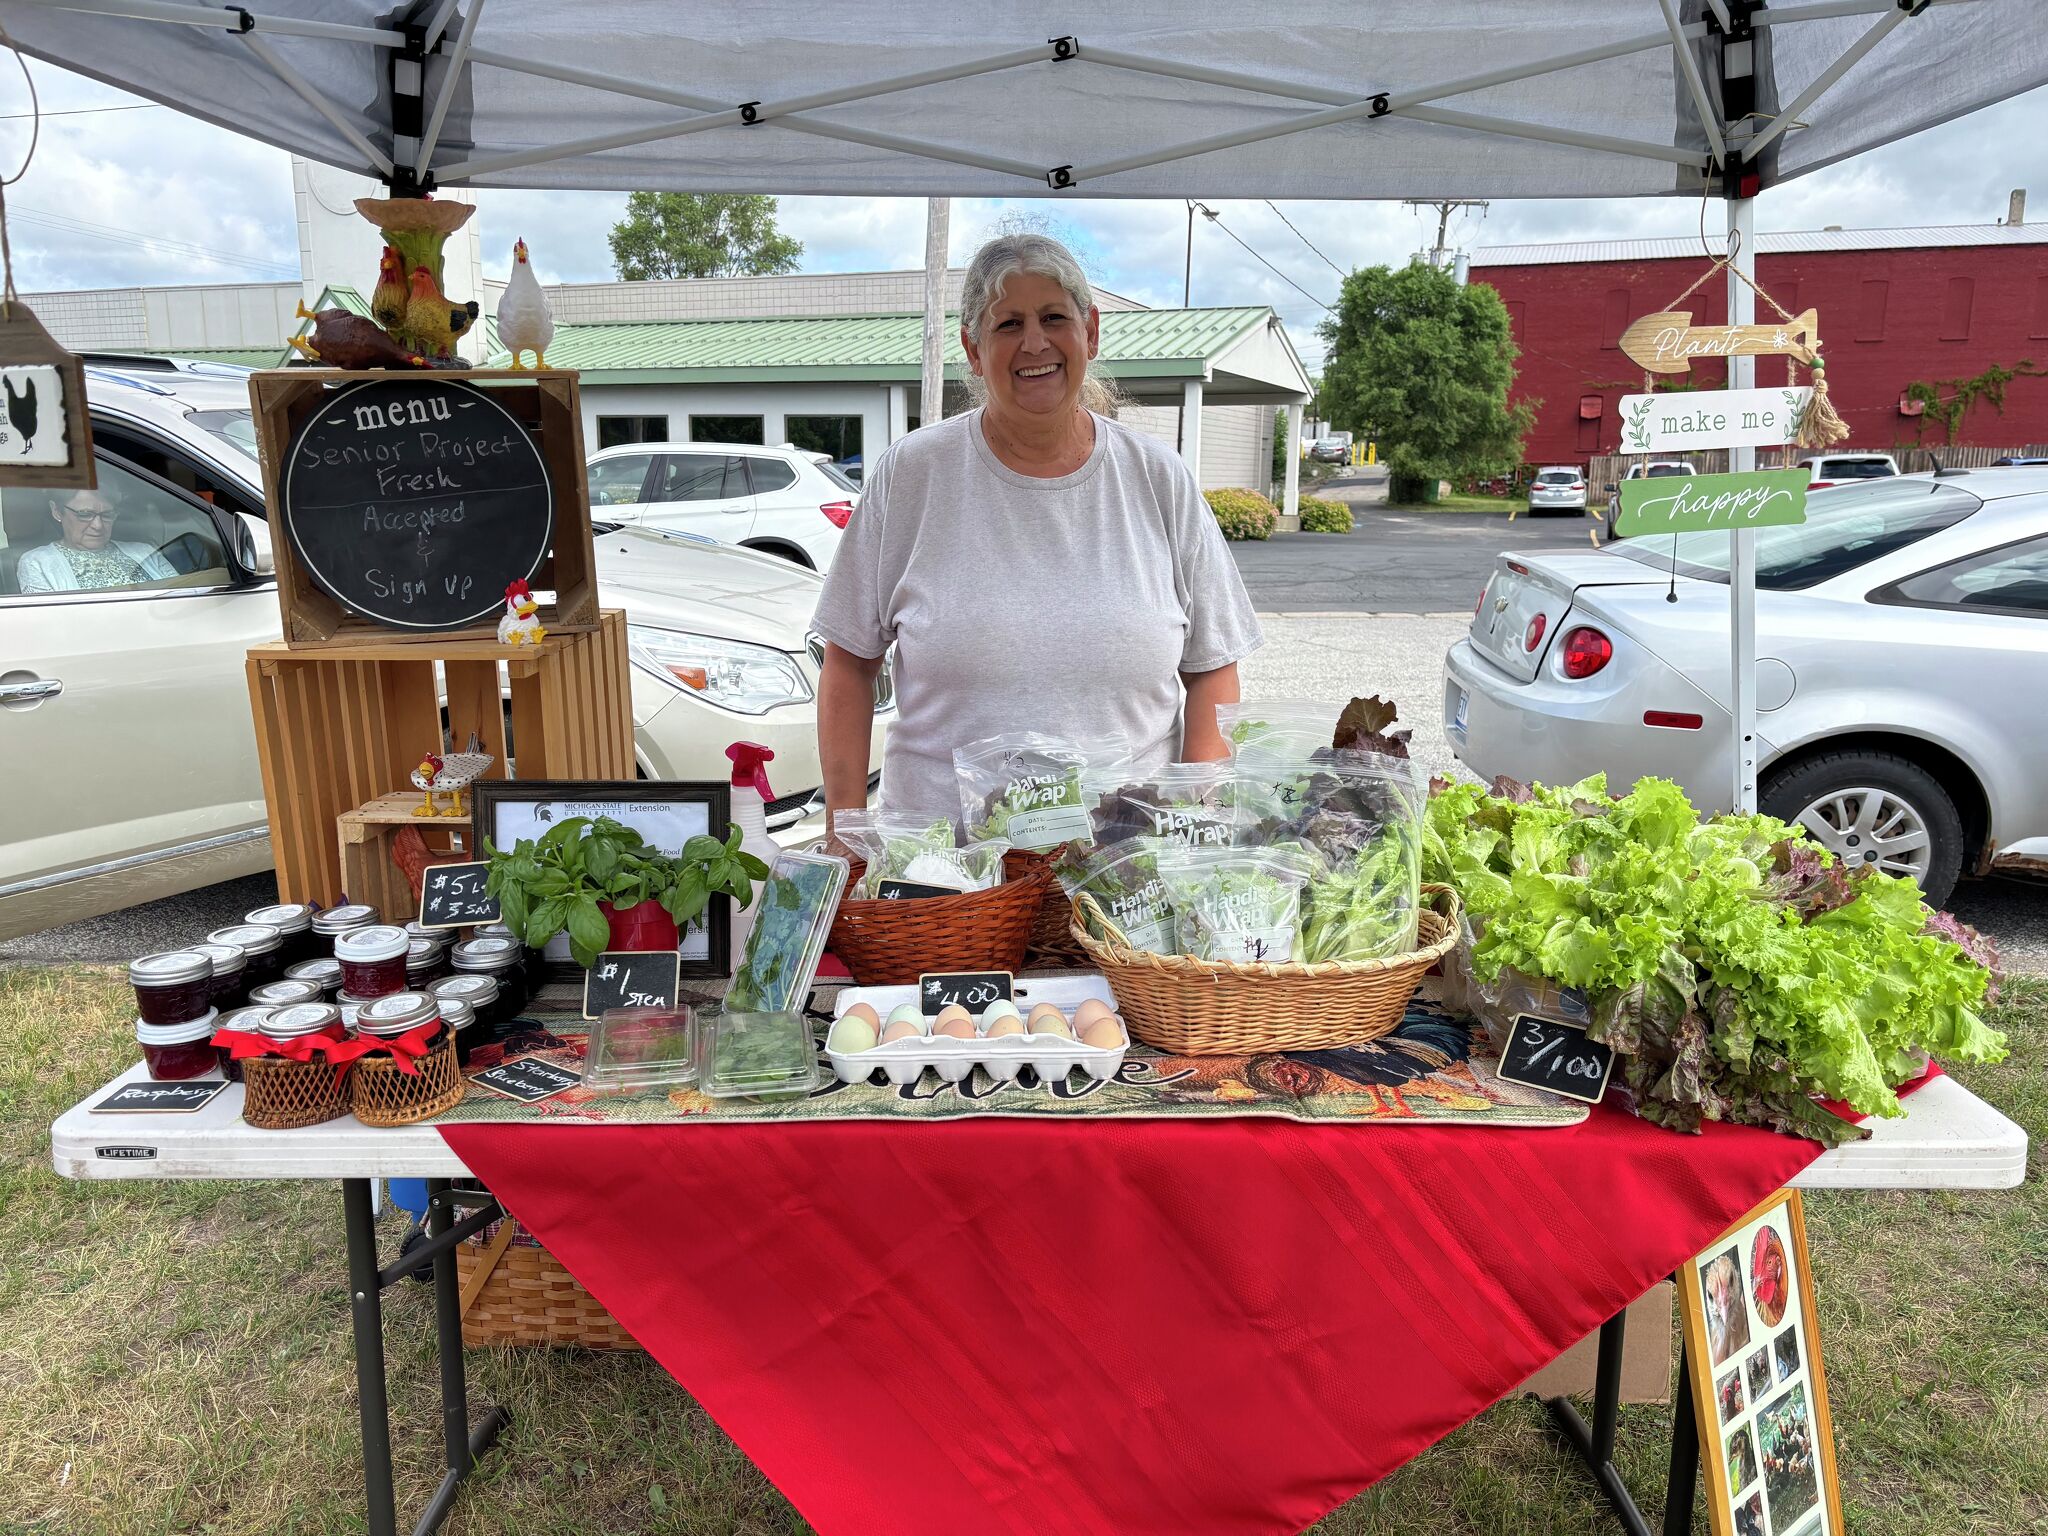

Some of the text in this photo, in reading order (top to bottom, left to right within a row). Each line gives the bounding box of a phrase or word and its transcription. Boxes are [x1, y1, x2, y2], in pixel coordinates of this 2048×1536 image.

[1653, 326, 1748, 361] Plants
[353, 396, 452, 431] menu
[1661, 410, 1775, 434] make me
[302, 432, 521, 469] Senior Project
[376, 464, 462, 496] Fresh
[363, 500, 466, 535] Accepted
[1640, 483, 1791, 523] happy
[365, 568, 427, 604] Sign
[629, 804, 671, 812] Extension
[1011, 782, 1066, 811] Wrap
[1122, 895, 1169, 928] Wrap
[103, 1149, 150, 1157] LIFETIME
